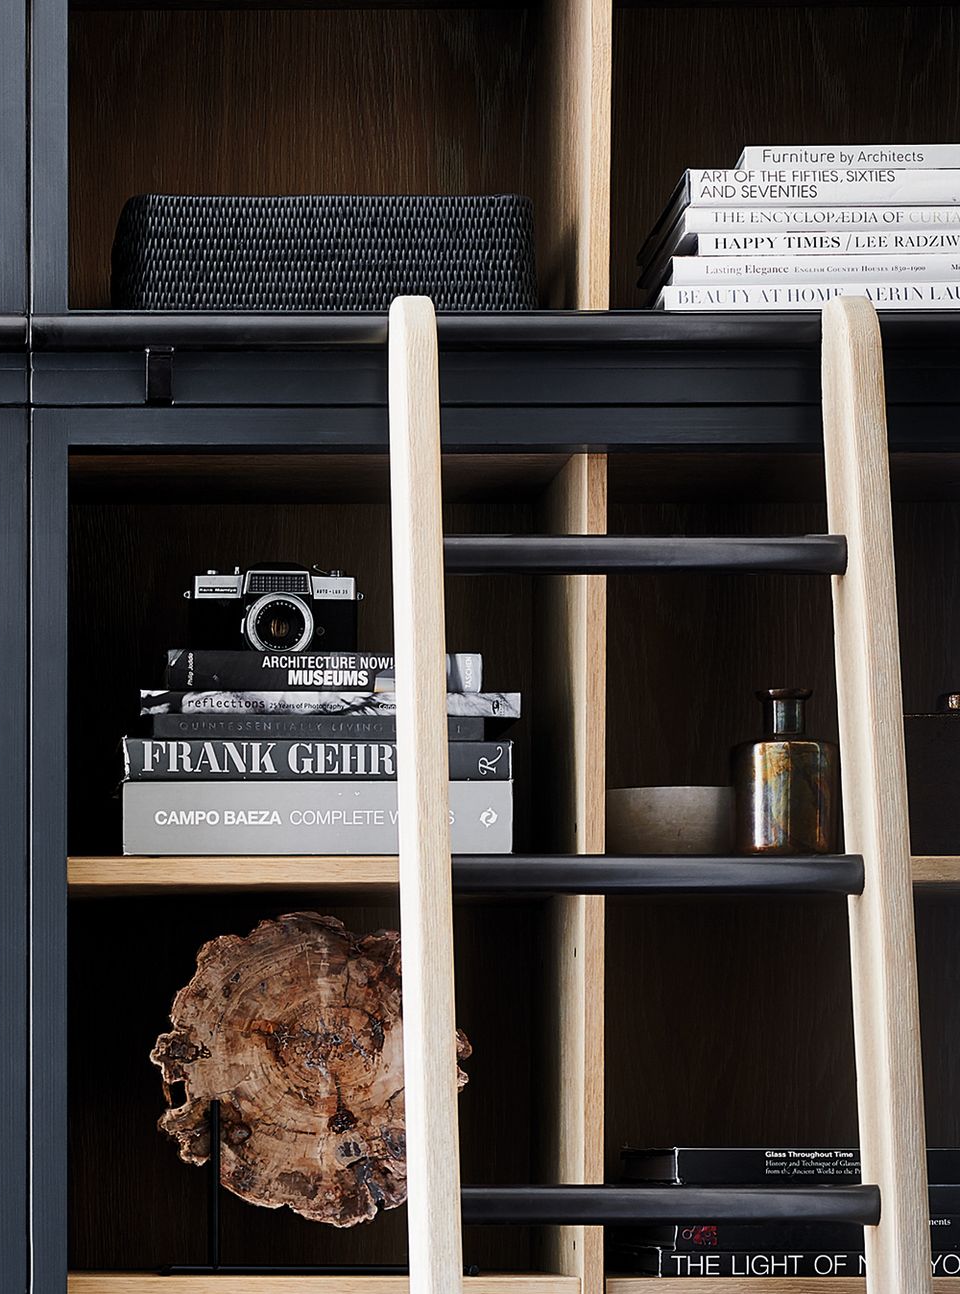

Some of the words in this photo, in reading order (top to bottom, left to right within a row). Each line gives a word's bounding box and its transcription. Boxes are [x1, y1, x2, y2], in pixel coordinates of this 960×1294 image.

[762, 149, 836, 163] Furniture
[840, 151, 854, 166] by
[857, 150, 924, 163] Architects
[700, 170, 729, 183] ART
[734, 170, 756, 183] OF
[760, 170, 787, 183] THE
[846, 170, 896, 183] SIXTIES
[700, 185, 737, 199] AND
[741, 184, 818, 199] SEVENTIES
[712, 211, 745, 224] THE
[882, 211, 904, 224] OF
[714, 237, 778, 250] HAPPY
[783, 236, 841, 249] TIMES
[855, 235, 888, 248] LEE
[705, 265, 742, 276] Lasting
[745, 264, 789, 276] Elegance
[678, 289, 753, 304] BEAUTY
[760, 288, 782, 303] AT
[262, 656, 358, 669] ARCHITECTURE
[288, 670, 369, 686] MUSEUMS
[464, 656, 472, 688] TASCHEN
[187, 698, 266, 709] reflections
[141, 741, 277, 774] FRANK
[154, 811, 220, 826] CAMPO
[224, 811, 282, 826] BAEZA
[290, 811, 385, 826] COMPLETE
[788, 1151, 833, 1159] Throughout
[671, 1255, 721, 1276] THE
[731, 1254, 804, 1276] LIGHT
[814, 1254, 848, 1275] OF
